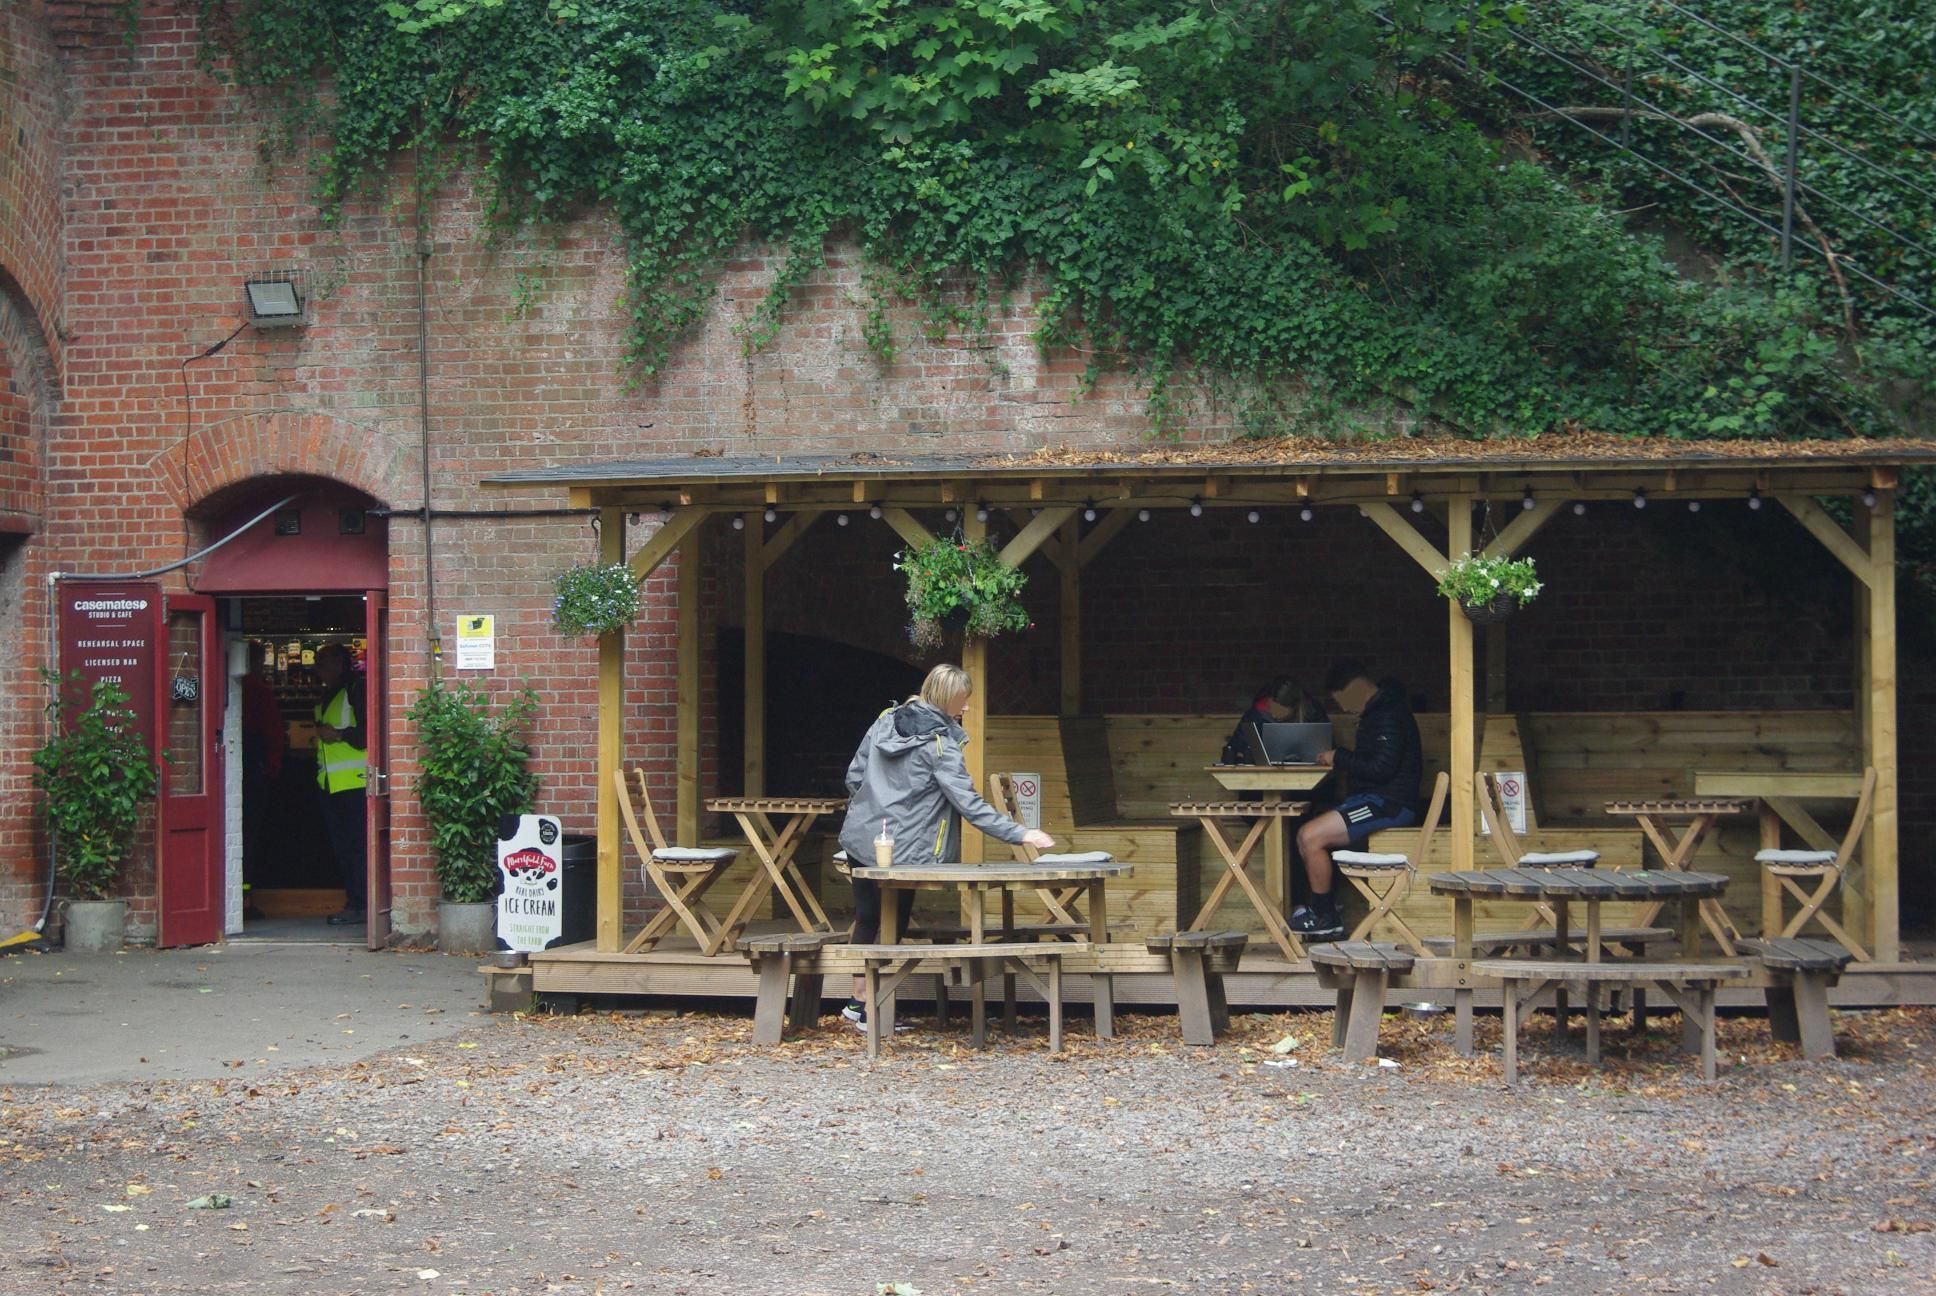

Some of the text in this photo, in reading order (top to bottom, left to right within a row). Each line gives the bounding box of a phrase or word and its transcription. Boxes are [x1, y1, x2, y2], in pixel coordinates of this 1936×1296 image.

[74, 600, 140, 610] casemates
[78, 640, 119, 648] REHEARSAL
[176, 682, 196, 698] OPEN
[515, 886, 528, 897] REAL
[505, 897, 556, 917] ICE CREAM
